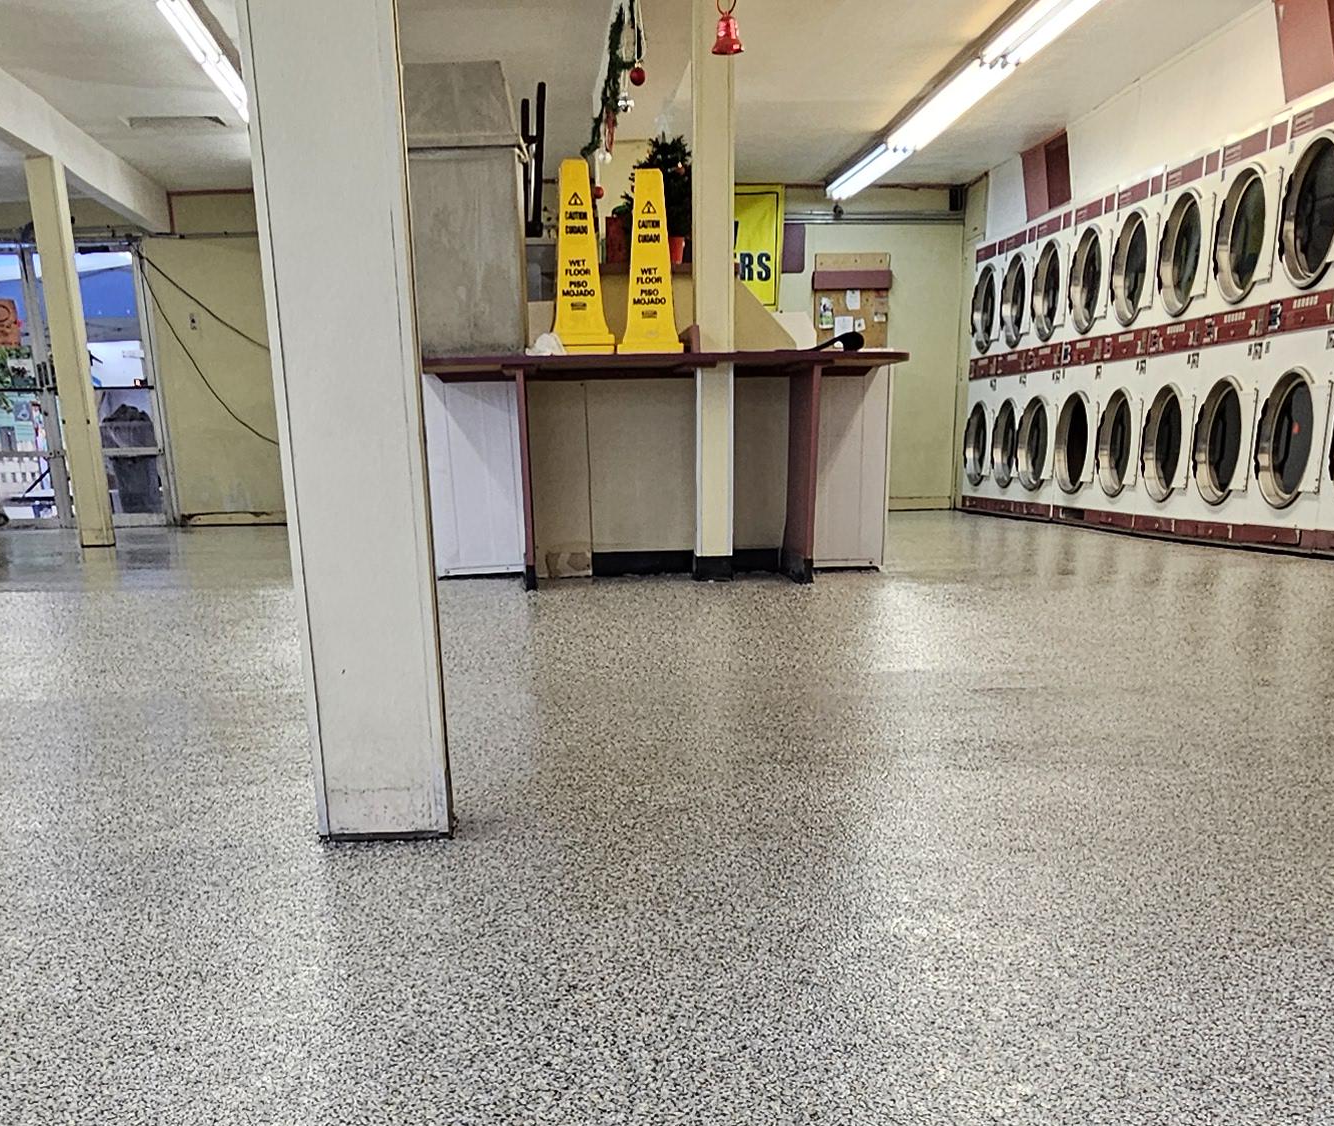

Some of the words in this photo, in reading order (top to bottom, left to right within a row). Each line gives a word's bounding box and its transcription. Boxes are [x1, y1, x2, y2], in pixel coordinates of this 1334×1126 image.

[565, 211, 588, 220] CAUTION
[638, 220, 660, 229] CAUTION
[569, 259, 586, 267] WET
[565, 268, 591, 276] FLOOR
[569, 280, 588, 288] PISO
[636, 276, 662, 285] FLOOR
[562, 289, 595, 297] MOJADO
[640, 289, 659, 297] PISO
[633, 297, 666, 305] MOJADO
